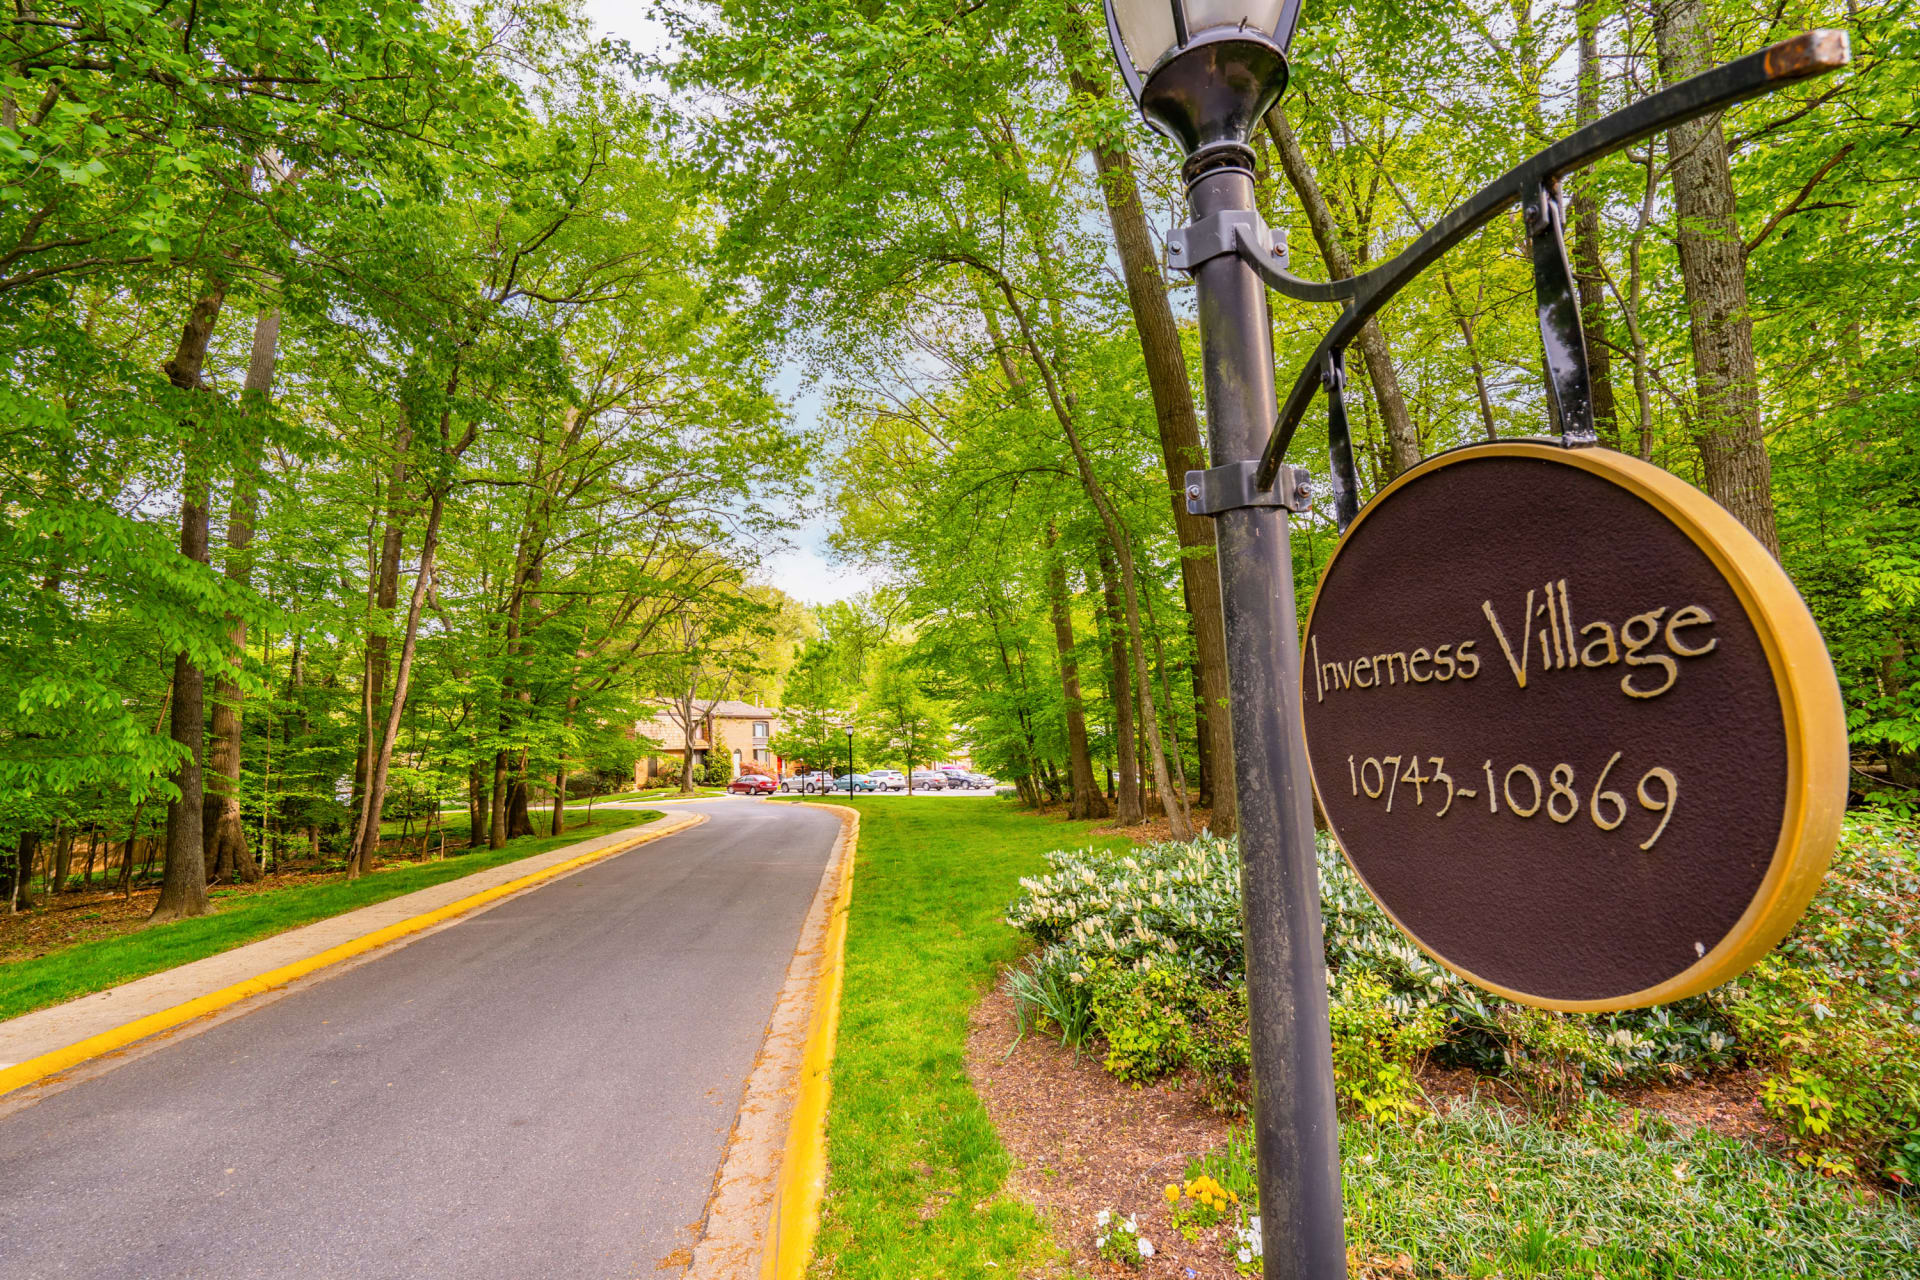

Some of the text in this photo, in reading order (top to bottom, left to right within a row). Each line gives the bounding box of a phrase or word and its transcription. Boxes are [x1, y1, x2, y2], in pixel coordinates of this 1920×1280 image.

[1311, 578, 1718, 702] Inverness Village
[1347, 751, 1678, 850] 10743-10869
